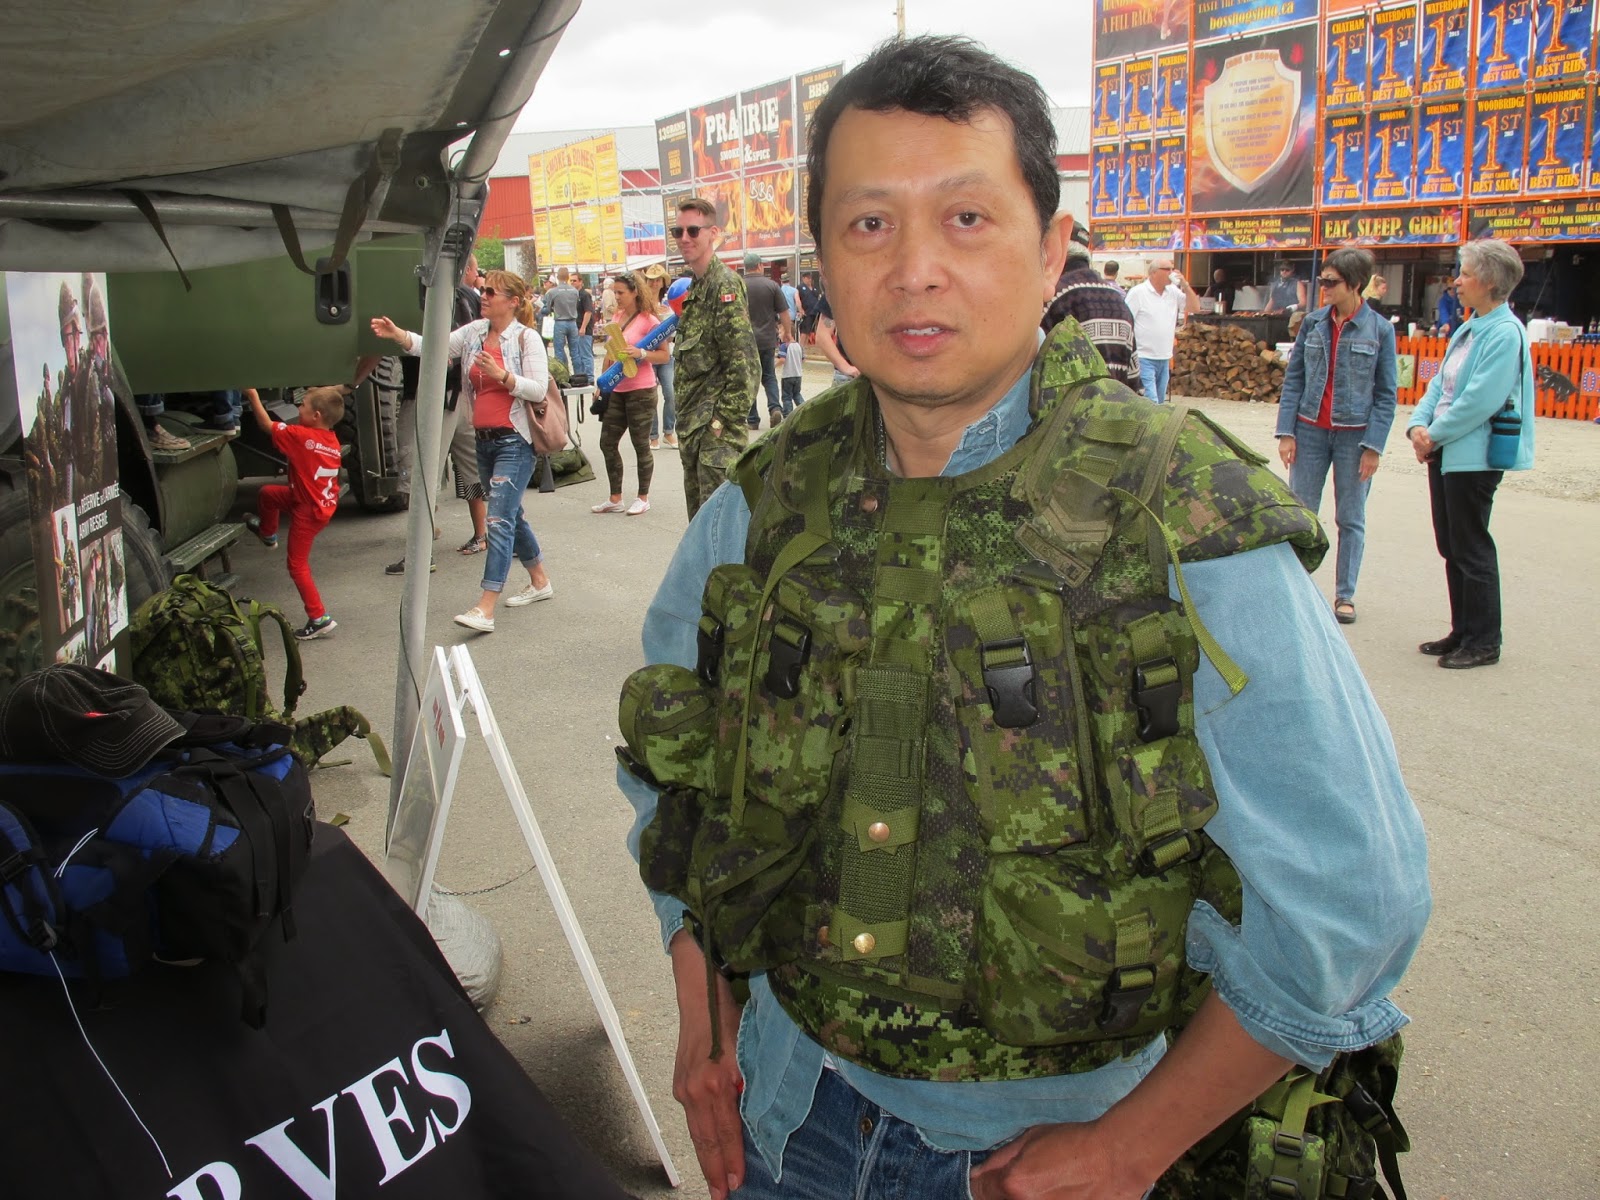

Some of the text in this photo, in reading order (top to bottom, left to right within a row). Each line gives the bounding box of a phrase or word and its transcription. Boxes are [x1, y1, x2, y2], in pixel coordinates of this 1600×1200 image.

[1426, 0, 1468, 15] WATERDOWN
[1570, 6, 1583, 14] 2013
[1209, 2, 1295, 30] bosshogsbbq.ca
[1376, 7, 1416, 24] WATERDOWN
[1102, 18, 1108, 34] A
[1110, 14, 1129, 32] FULL
[1332, 19, 1365, 34] CHATHAM
[1126, 60, 1153, 73] PICKERING
[1158, 54, 1187, 67] PICKERING
[1535, 58, 1588, 78] BEST RIBS
[1482, 68, 1521, 83] BEST SAUCE
[1422, 75, 1466, 93] BEST RIBS
[1326, 94, 1343, 106] BEST
[1373, 86, 1413, 101] BEST RIBS
[1535, 88, 1586, 104] WOODBRIDGE
[1426, 103, 1459, 115] BURLINGTON
[1478, 96, 1525, 112] WOODBRIDGE
[705, 96, 779, 147] PRAIRIE
[720, 147, 741, 162] SMOKE
[752, 148, 770, 162] SPICE
[1422, 182, 1456, 193] BEST RIBS
[1472, 178, 1520, 193] BEST SAUCE
[1529, 176, 1554, 189] BEST
[1555, 174, 1580, 187] RIBS
[750, 179, 779, 211] BBQ
[1219, 218, 1281, 229] The Bosses Feast
[1324, 215, 1456, 239] EAT, SLEEP, GRILL
[1540, 217, 1558, 226] PULLED
[1559, 216, 1574, 225] PORK
[1233, 234, 1267, 245] $25.00
[314, 465, 339, 500] 7
[90, 510, 108, 533] RESERVE
